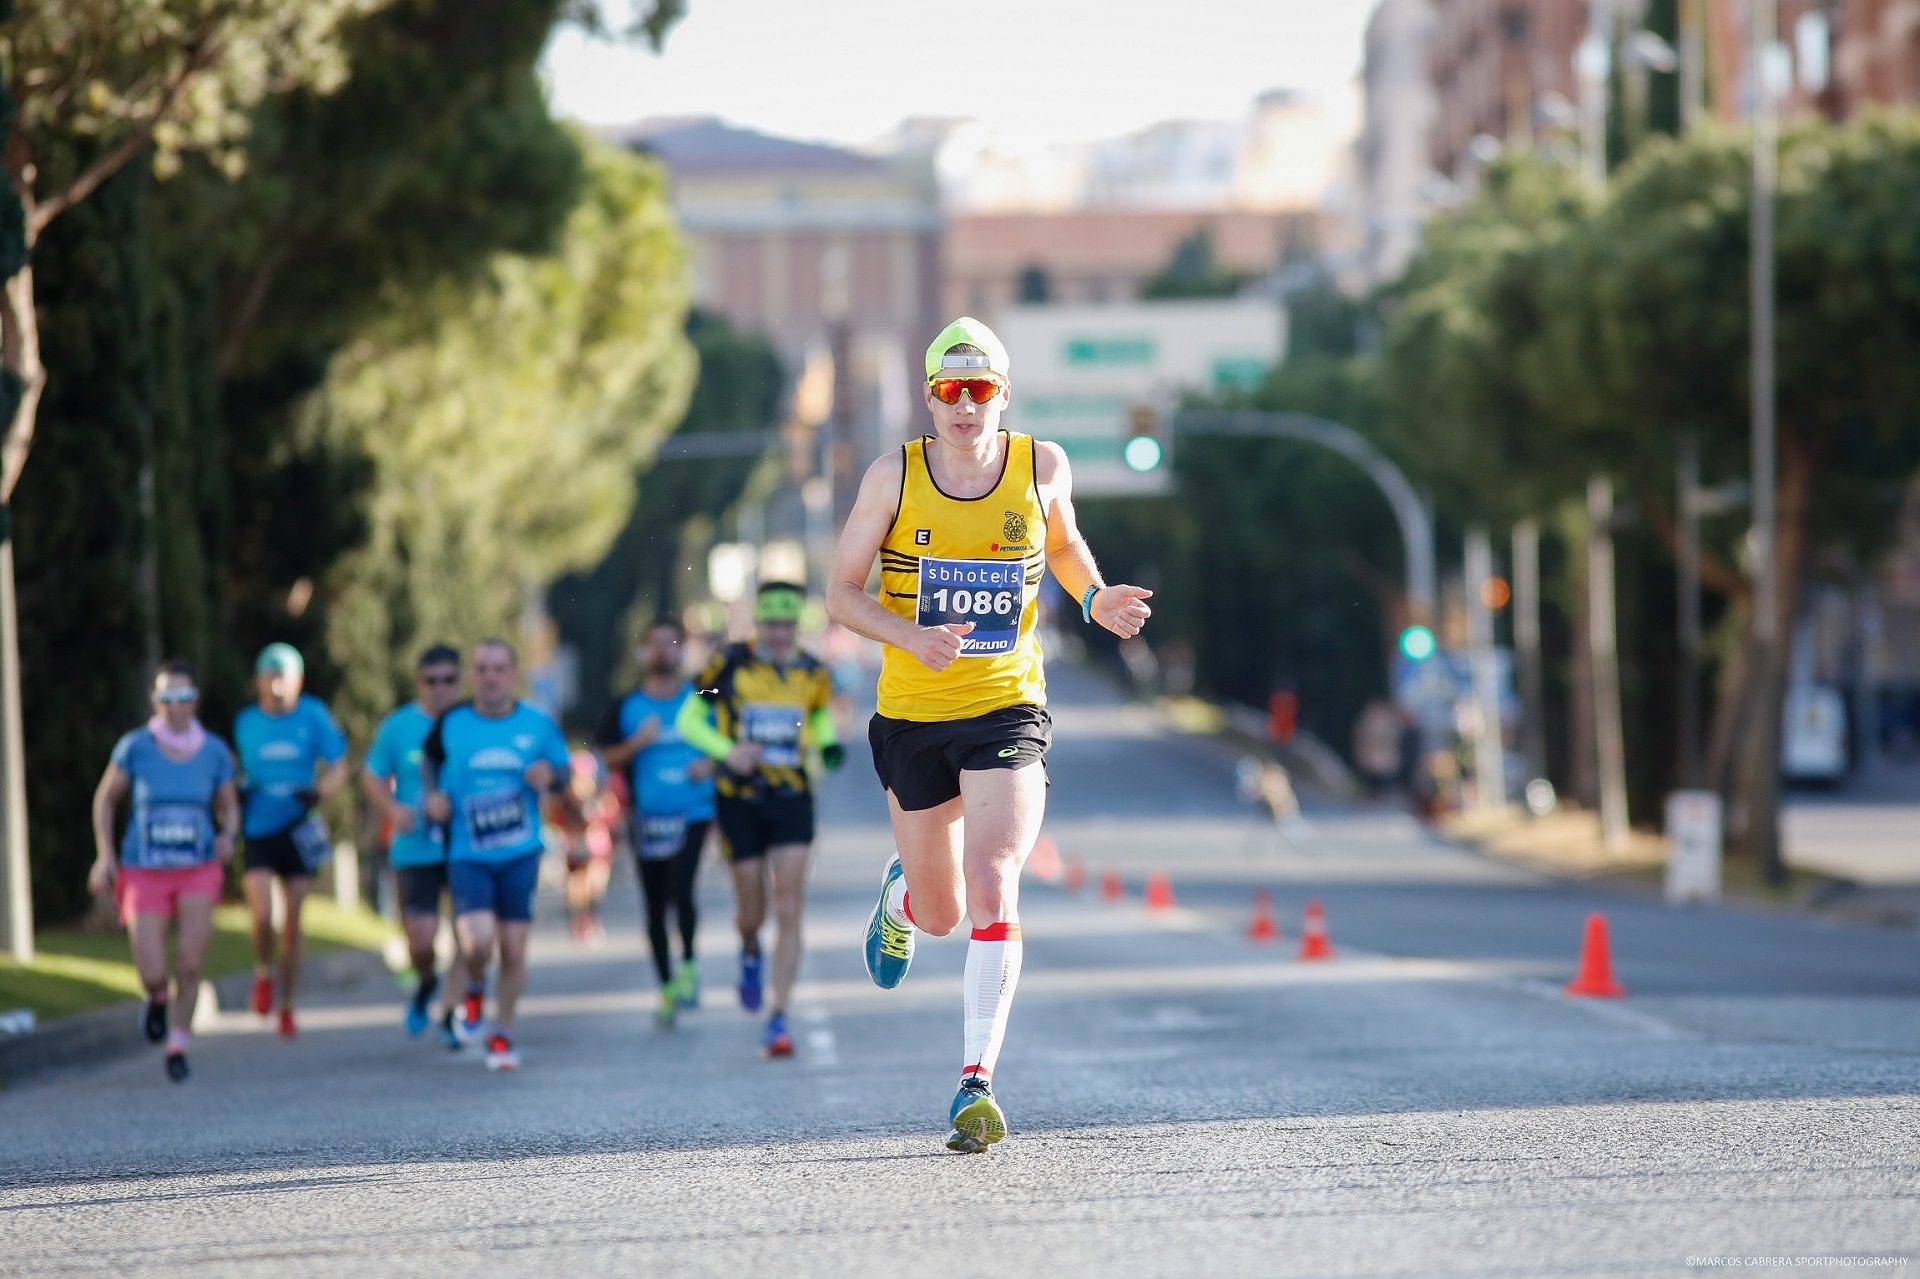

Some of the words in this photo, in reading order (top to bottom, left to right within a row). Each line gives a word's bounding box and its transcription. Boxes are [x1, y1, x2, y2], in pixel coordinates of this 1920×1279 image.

[918, 531, 928, 543] E
[928, 566, 1019, 583] sbhotels
[933, 588, 1012, 615] 1086
